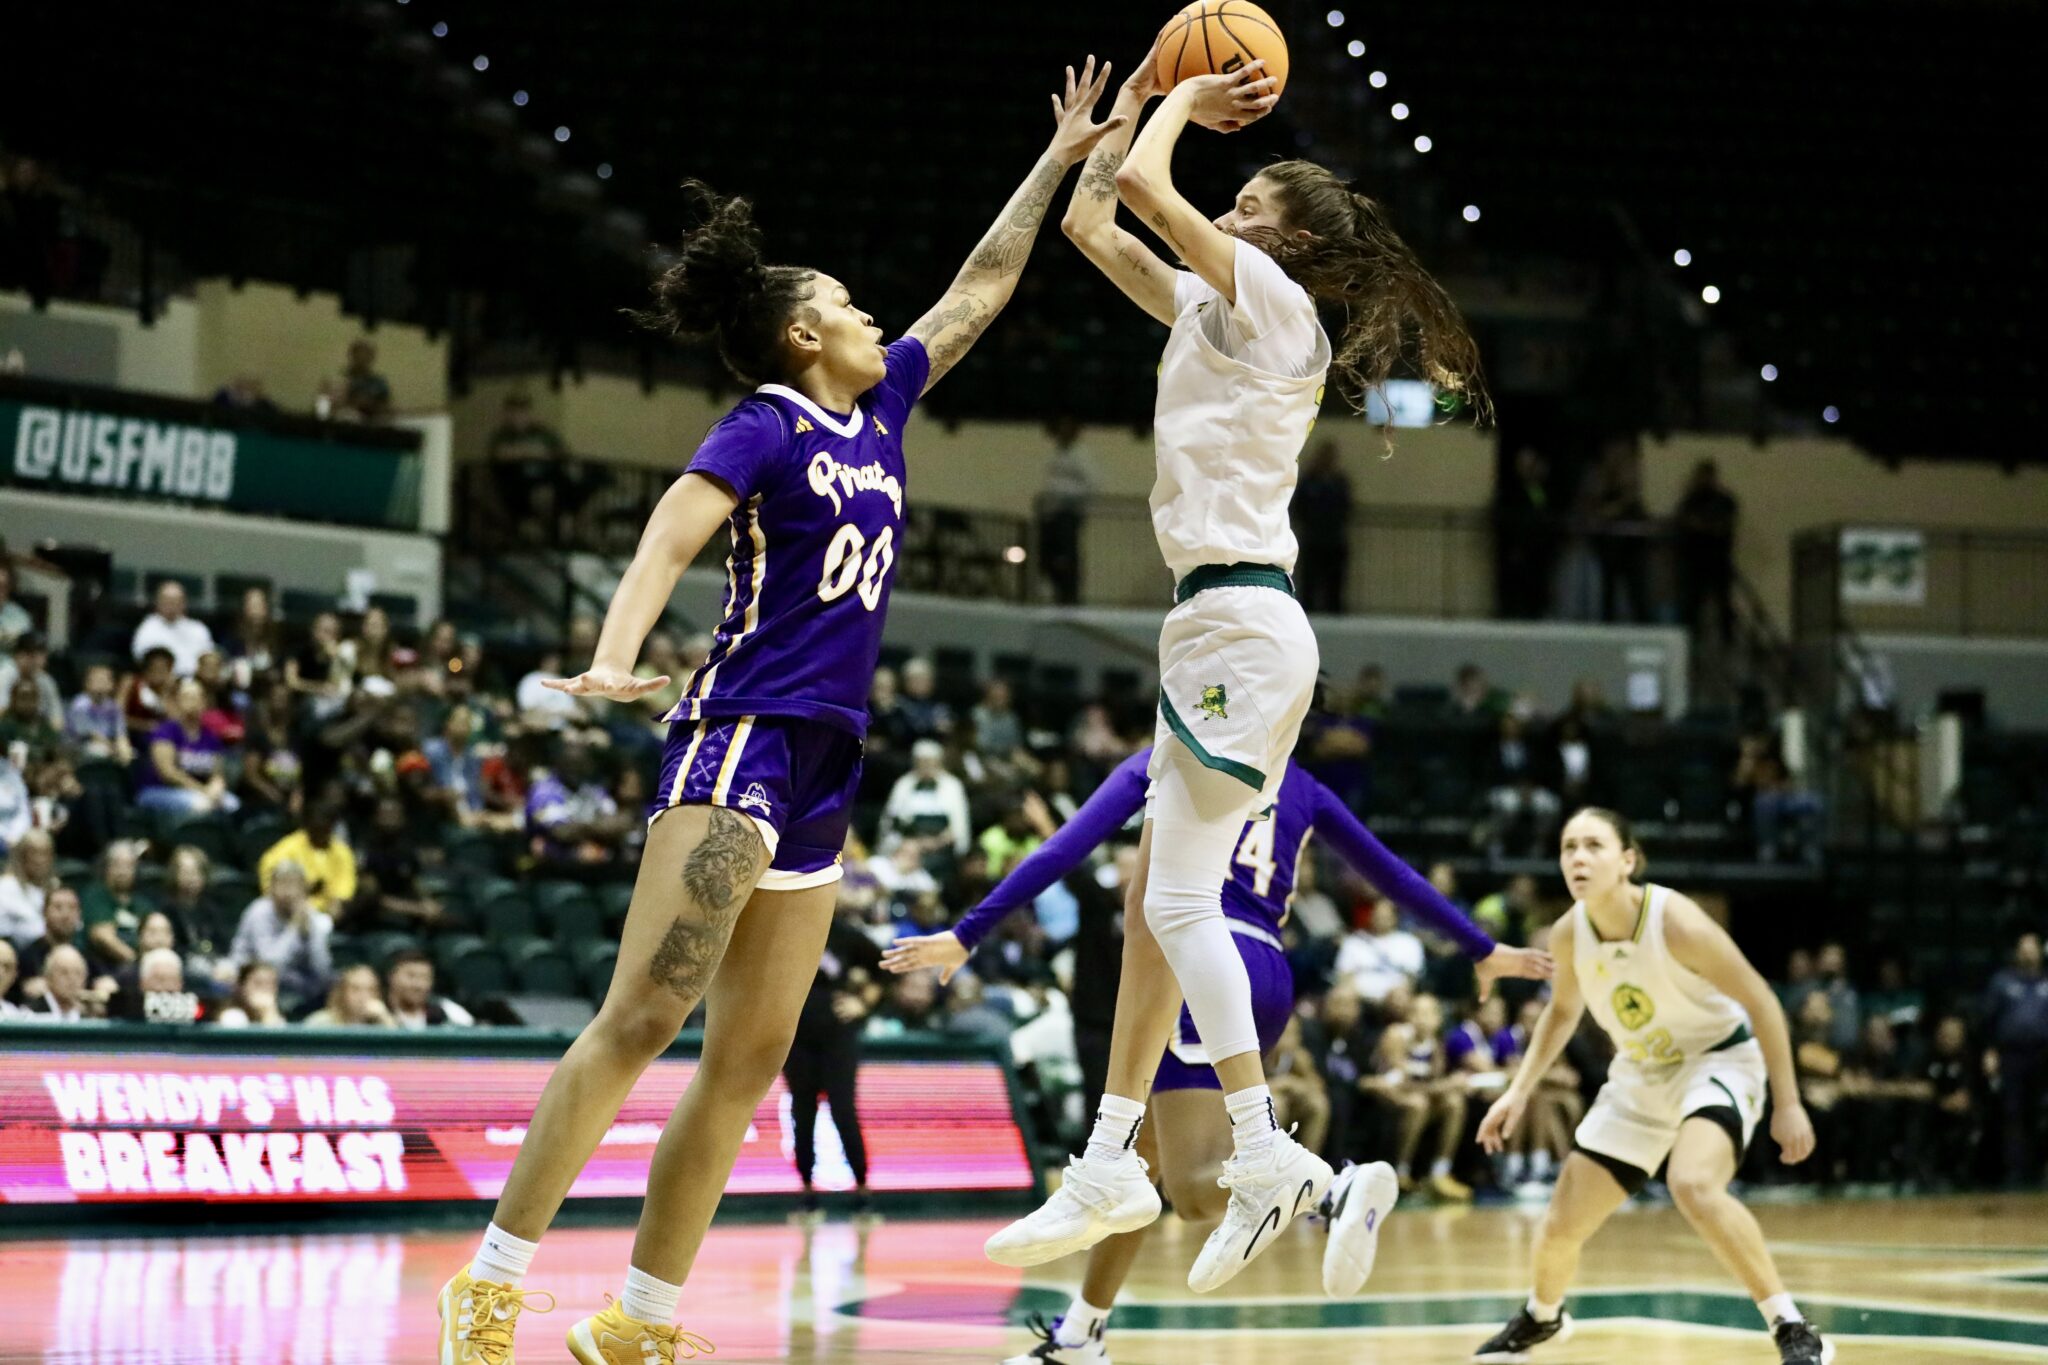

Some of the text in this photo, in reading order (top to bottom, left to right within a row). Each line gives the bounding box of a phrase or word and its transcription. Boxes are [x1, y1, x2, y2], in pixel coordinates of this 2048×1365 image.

[15, 405, 237, 499] @USFMBB
[817, 523, 894, 612] 00
[1225, 808, 1278, 898] 4
[292, 1075, 396, 1126] HAS
[59, 1132, 407, 1192] BREAKFAST
